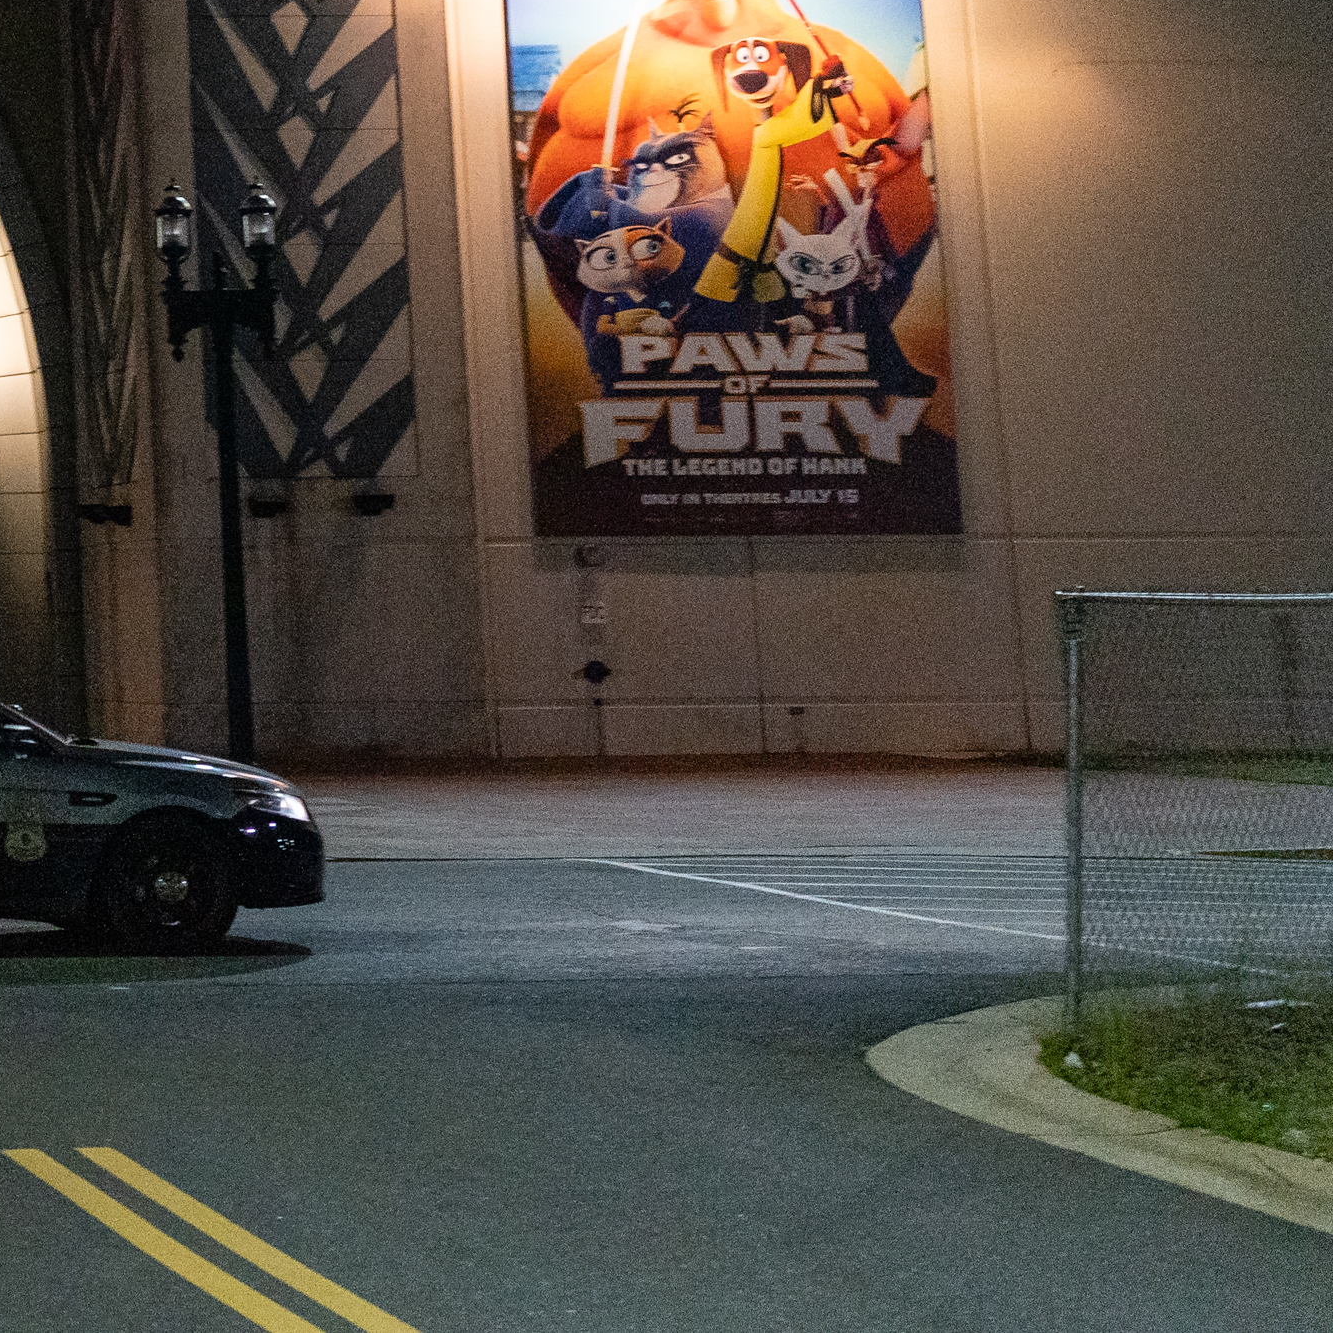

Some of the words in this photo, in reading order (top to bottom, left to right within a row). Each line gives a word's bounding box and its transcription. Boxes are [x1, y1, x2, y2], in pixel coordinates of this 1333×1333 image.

[620, 333, 870, 373] PAWS
[723, 375, 770, 395] OF
[579, 396, 930, 468] FURY
[622, 458, 669, 476] THE
[673, 458, 763, 475] LEGEND
[767, 457, 798, 475] OF
